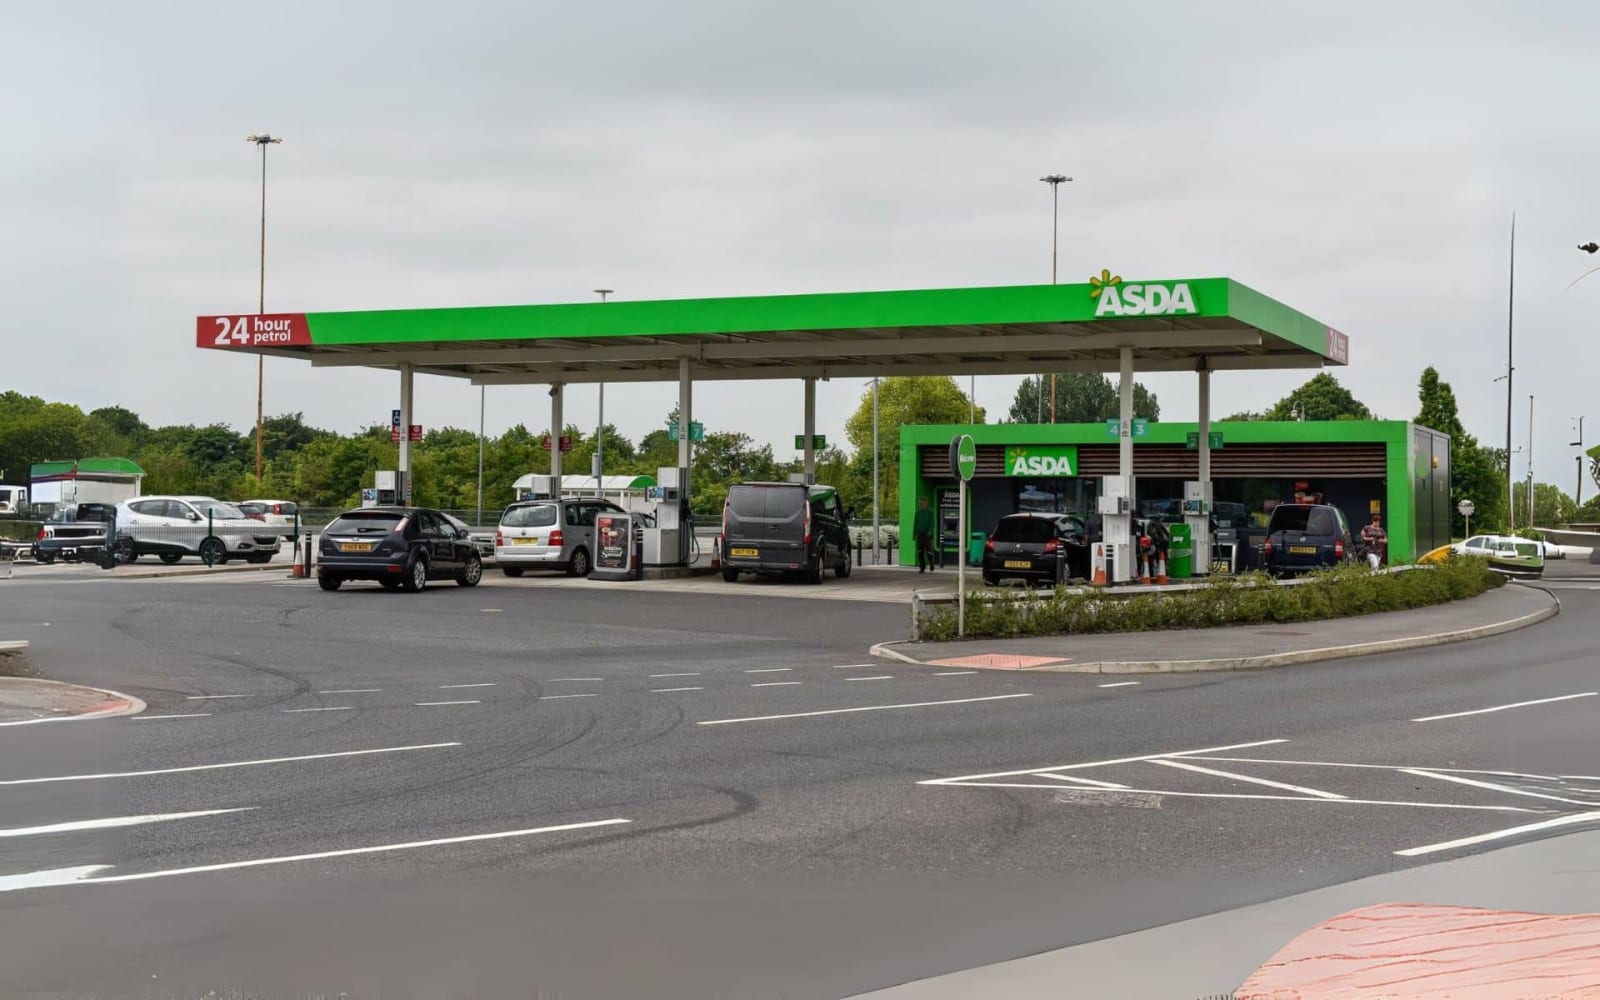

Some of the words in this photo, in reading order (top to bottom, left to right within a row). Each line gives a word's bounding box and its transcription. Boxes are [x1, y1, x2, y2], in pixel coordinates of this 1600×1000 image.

[1095, 283, 1196, 317] ASDA
[215, 317, 250, 345] 24
[254, 317, 291, 331] hour
[254, 330, 291, 345] petrol
[1110, 424, 1118, 436] 4
[1136, 424, 1144, 435] 3
[1012, 456, 1073, 476] ASDA
